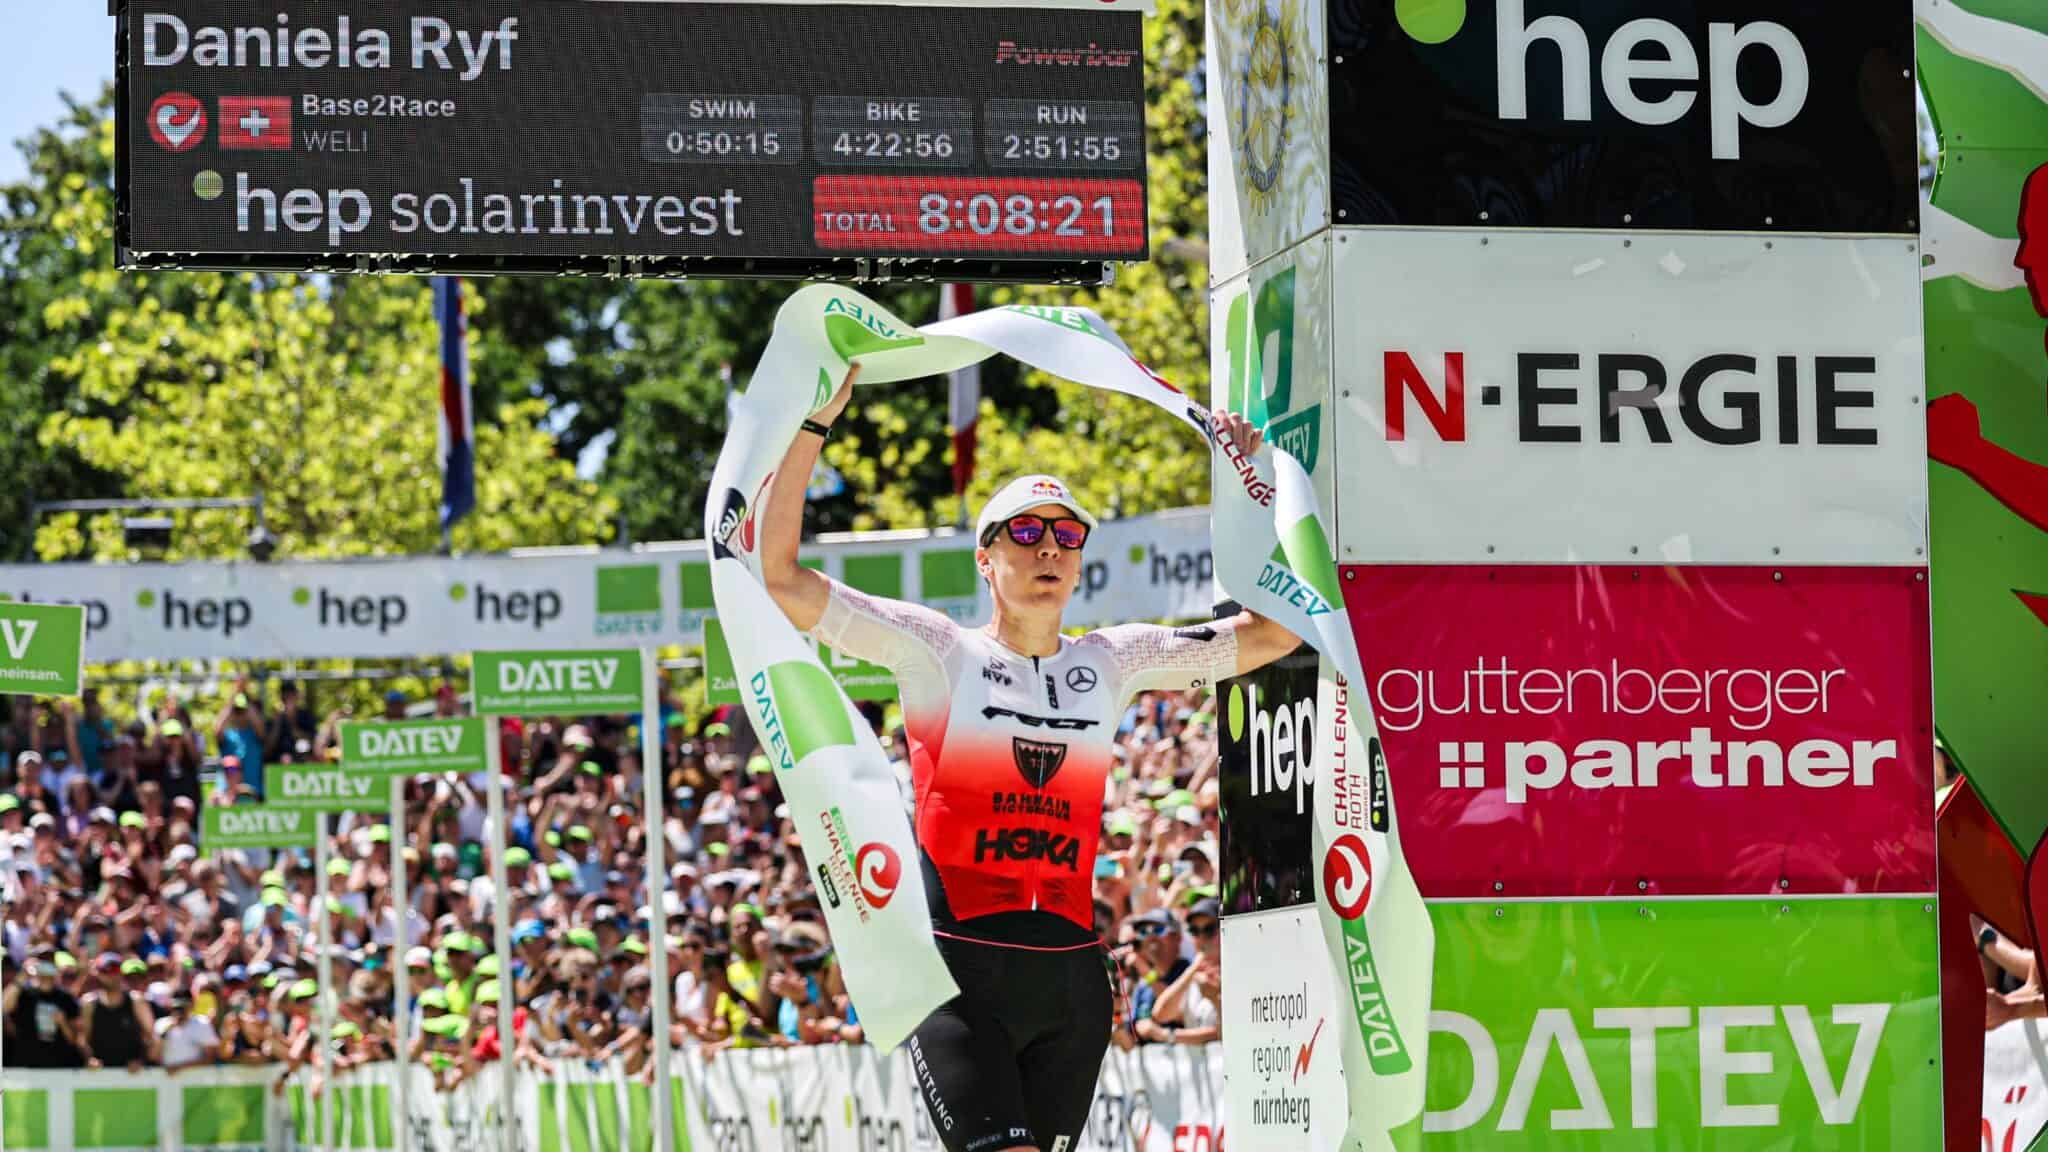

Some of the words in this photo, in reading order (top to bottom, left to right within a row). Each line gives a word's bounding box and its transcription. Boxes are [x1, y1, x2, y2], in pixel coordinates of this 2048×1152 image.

[143, 13, 390, 70] Daniela
[410, 15, 518, 81] Ryf
[1496, 0, 1809, 160] hep
[303, 94, 456, 118] Base2Race
[689, 100, 756, 119] SWIM
[866, 102, 921, 122] BIKE
[1037, 105, 1088, 125] RUN
[303, 129, 368, 152] WELI
[666, 131, 780, 155] 0:50:15
[832, 132, 953, 158] 4:22:56
[1003, 136, 1120, 160] 2:51:55
[236, 172, 372, 246] hep
[390, 178, 743, 237] solarinvest
[822, 213, 896, 233] TOTAL
[918, 192, 1114, 237] 8:08:21
[824, 297, 905, 338] ATEV
[1213, 416, 1276, 507] LLENGE
[1278, 422, 1311, 464] ATEV
[1148, 541, 1213, 592] hep
[1256, 563, 1331, 617] DATEV
[163, 588, 252, 636] hep
[319, 586, 407, 635] hep
[475, 583, 562, 628] hep
[499, 657, 620, 692] DATEV
[1377, 655, 1846, 731] guttenberger
[359, 725, 463, 757] DATEV
[751, 671, 794, 769] DATEV
[1248, 683, 1316, 815] hep
[1334, 671, 1348, 827] CHALLENGE
[1506, 727, 1897, 804] partner
[282, 771, 372, 797] DATEV
[1349, 774, 1363, 830] ROTH
[1373, 753, 1385, 808] hep
[219, 811, 301, 835] DATEV
[975, 827, 1080, 873] HOKA
[1251, 981, 1308, 1030] metropol
[1346, 934, 1400, 1058] DATEV
[910, 1034, 955, 1132] BREITLING
[1252, 1037, 1292, 1083] region
[1423, 1003, 1891, 1133] DATEV
[1253, 1087, 1311, 1133] nürnberg
